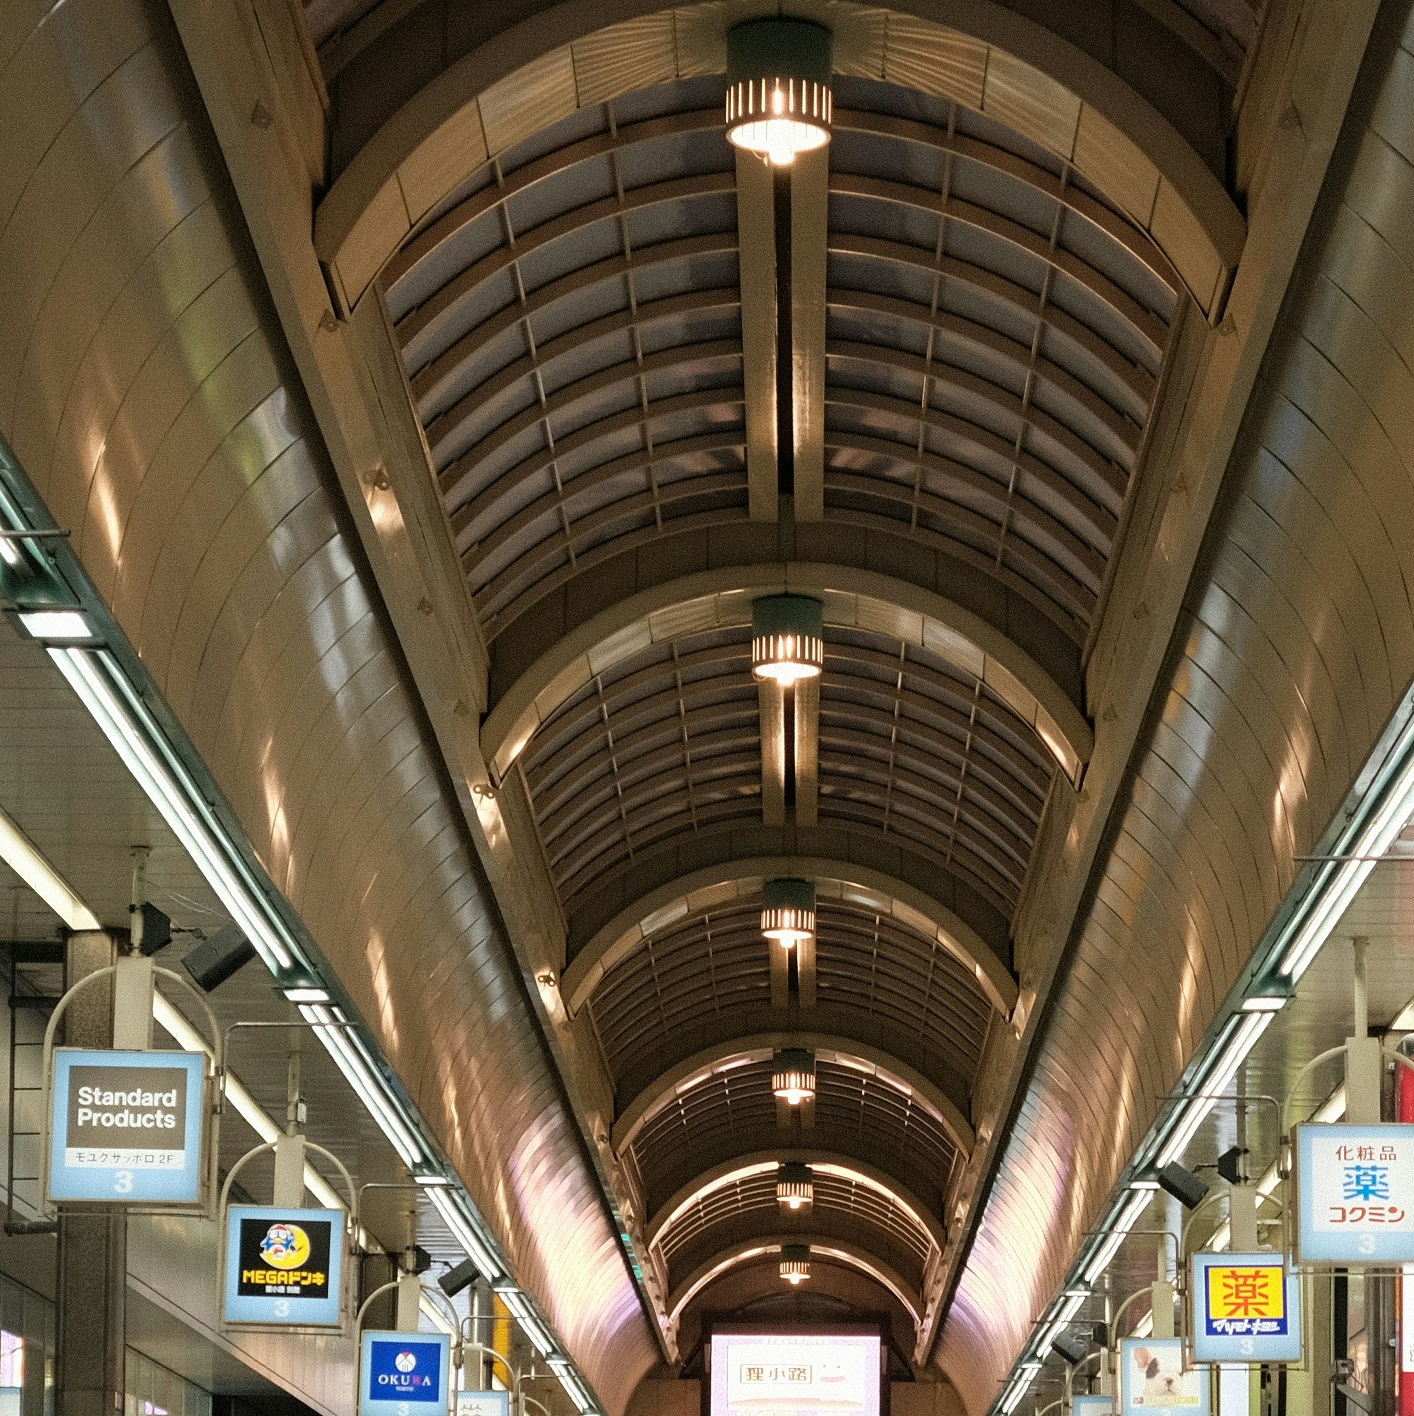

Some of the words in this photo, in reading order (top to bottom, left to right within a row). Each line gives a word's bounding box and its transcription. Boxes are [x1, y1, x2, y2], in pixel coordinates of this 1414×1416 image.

[78, 1086, 176, 1107] Standard
[77, 1108, 175, 1128] Products
[76, 1152, 154, 1163] モユクサッポロ
[159, 1154, 173, 1163] 2F
[1336, 1146, 1397, 1161] 化粧品
[114, 1170, 133, 1193] 3
[1343, 1165, 1389, 1201] 薬
[1330, 1207, 1405, 1223] コクミン
[1358, 1233, 1375, 1254] 3
[242, 1270, 325, 1286] MEGAドンキ
[1222, 1270, 1269, 1316] 薬
[274, 1301, 289, 1317] 3
[1241, 1337, 1254, 1354] 3
[378, 1374, 431, 1386] OKURA
[746, 1366, 807, 1382] 狸小路
[398, 1404, 410, 1416] 3
